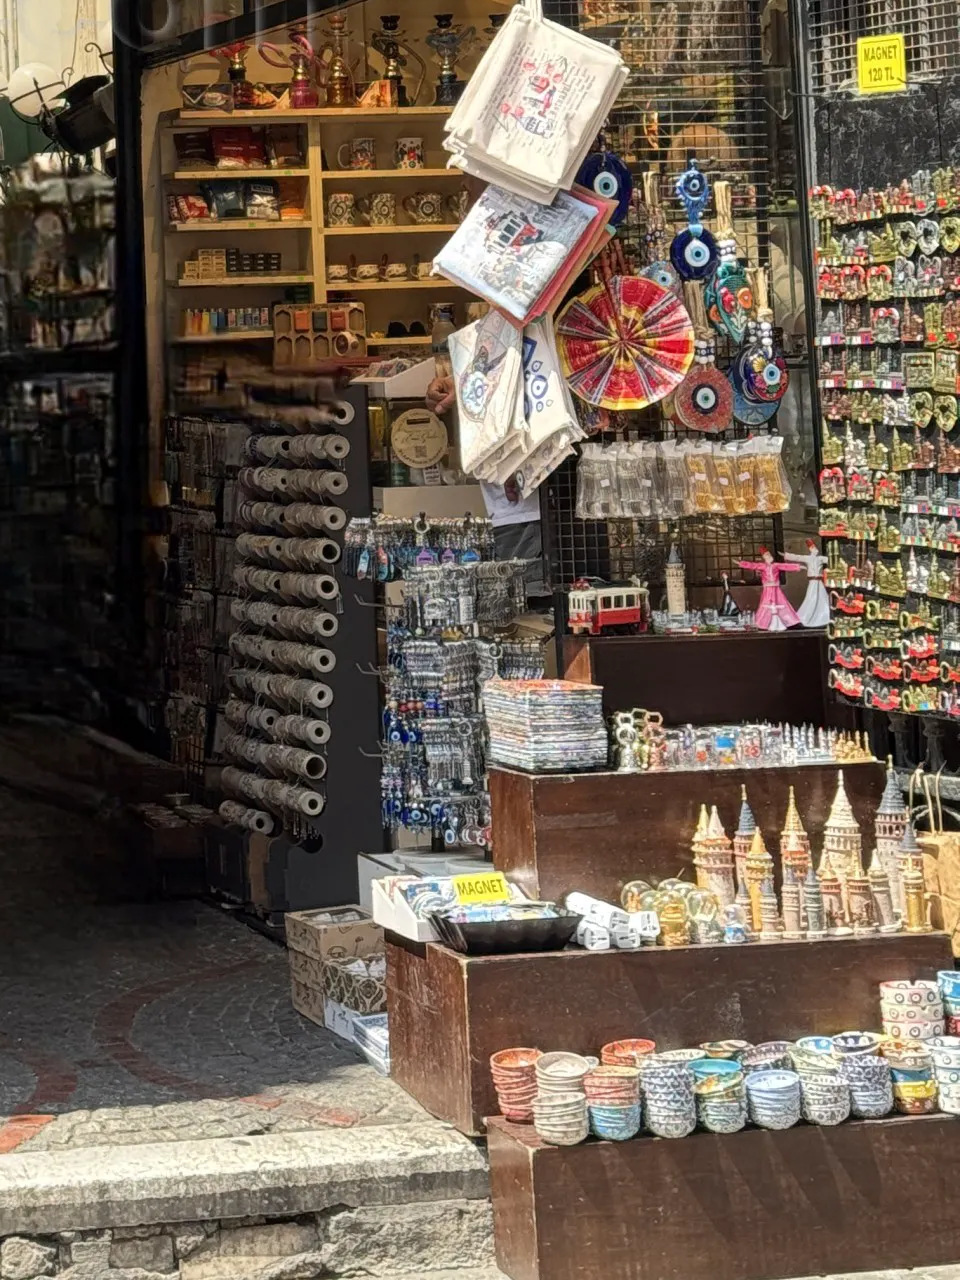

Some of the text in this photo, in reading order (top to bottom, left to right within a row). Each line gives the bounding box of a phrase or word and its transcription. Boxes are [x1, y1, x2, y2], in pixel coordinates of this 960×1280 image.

[864, 45, 898, 62] MAGNET
[868, 66, 895, 82] 120 TL
[456, 878, 504, 896] MAGNET
